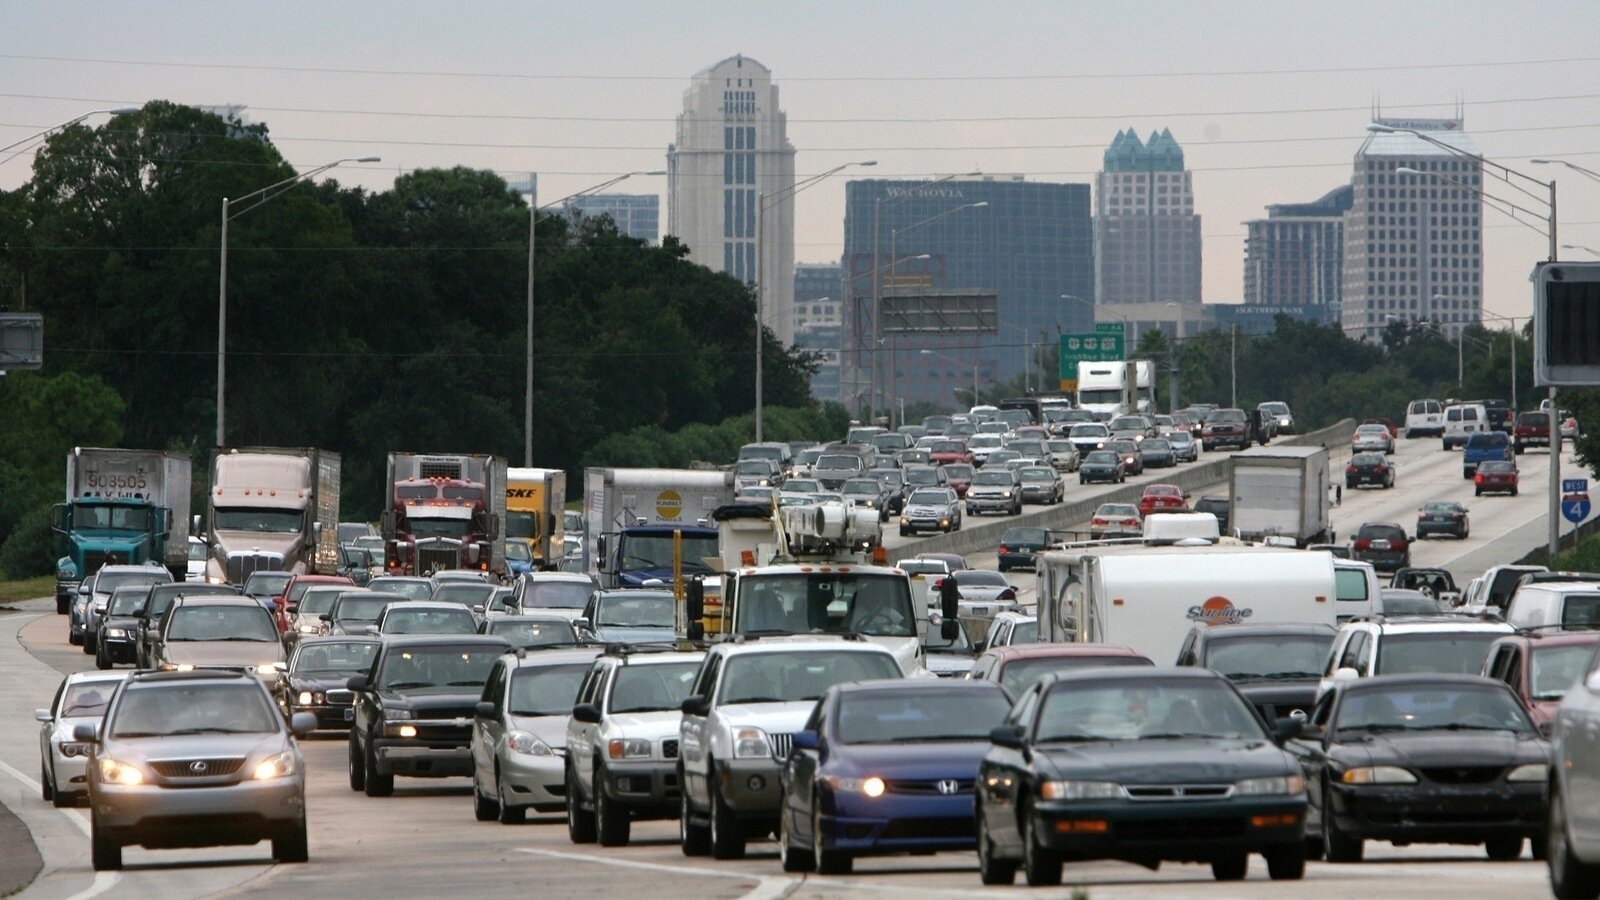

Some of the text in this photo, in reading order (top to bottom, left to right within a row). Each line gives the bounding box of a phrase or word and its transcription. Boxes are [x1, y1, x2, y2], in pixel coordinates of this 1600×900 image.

[1564, 481, 1586, 491] WEST
[1570, 501, 1583, 518] 4
[1186, 605, 1253, 619] Sunline
